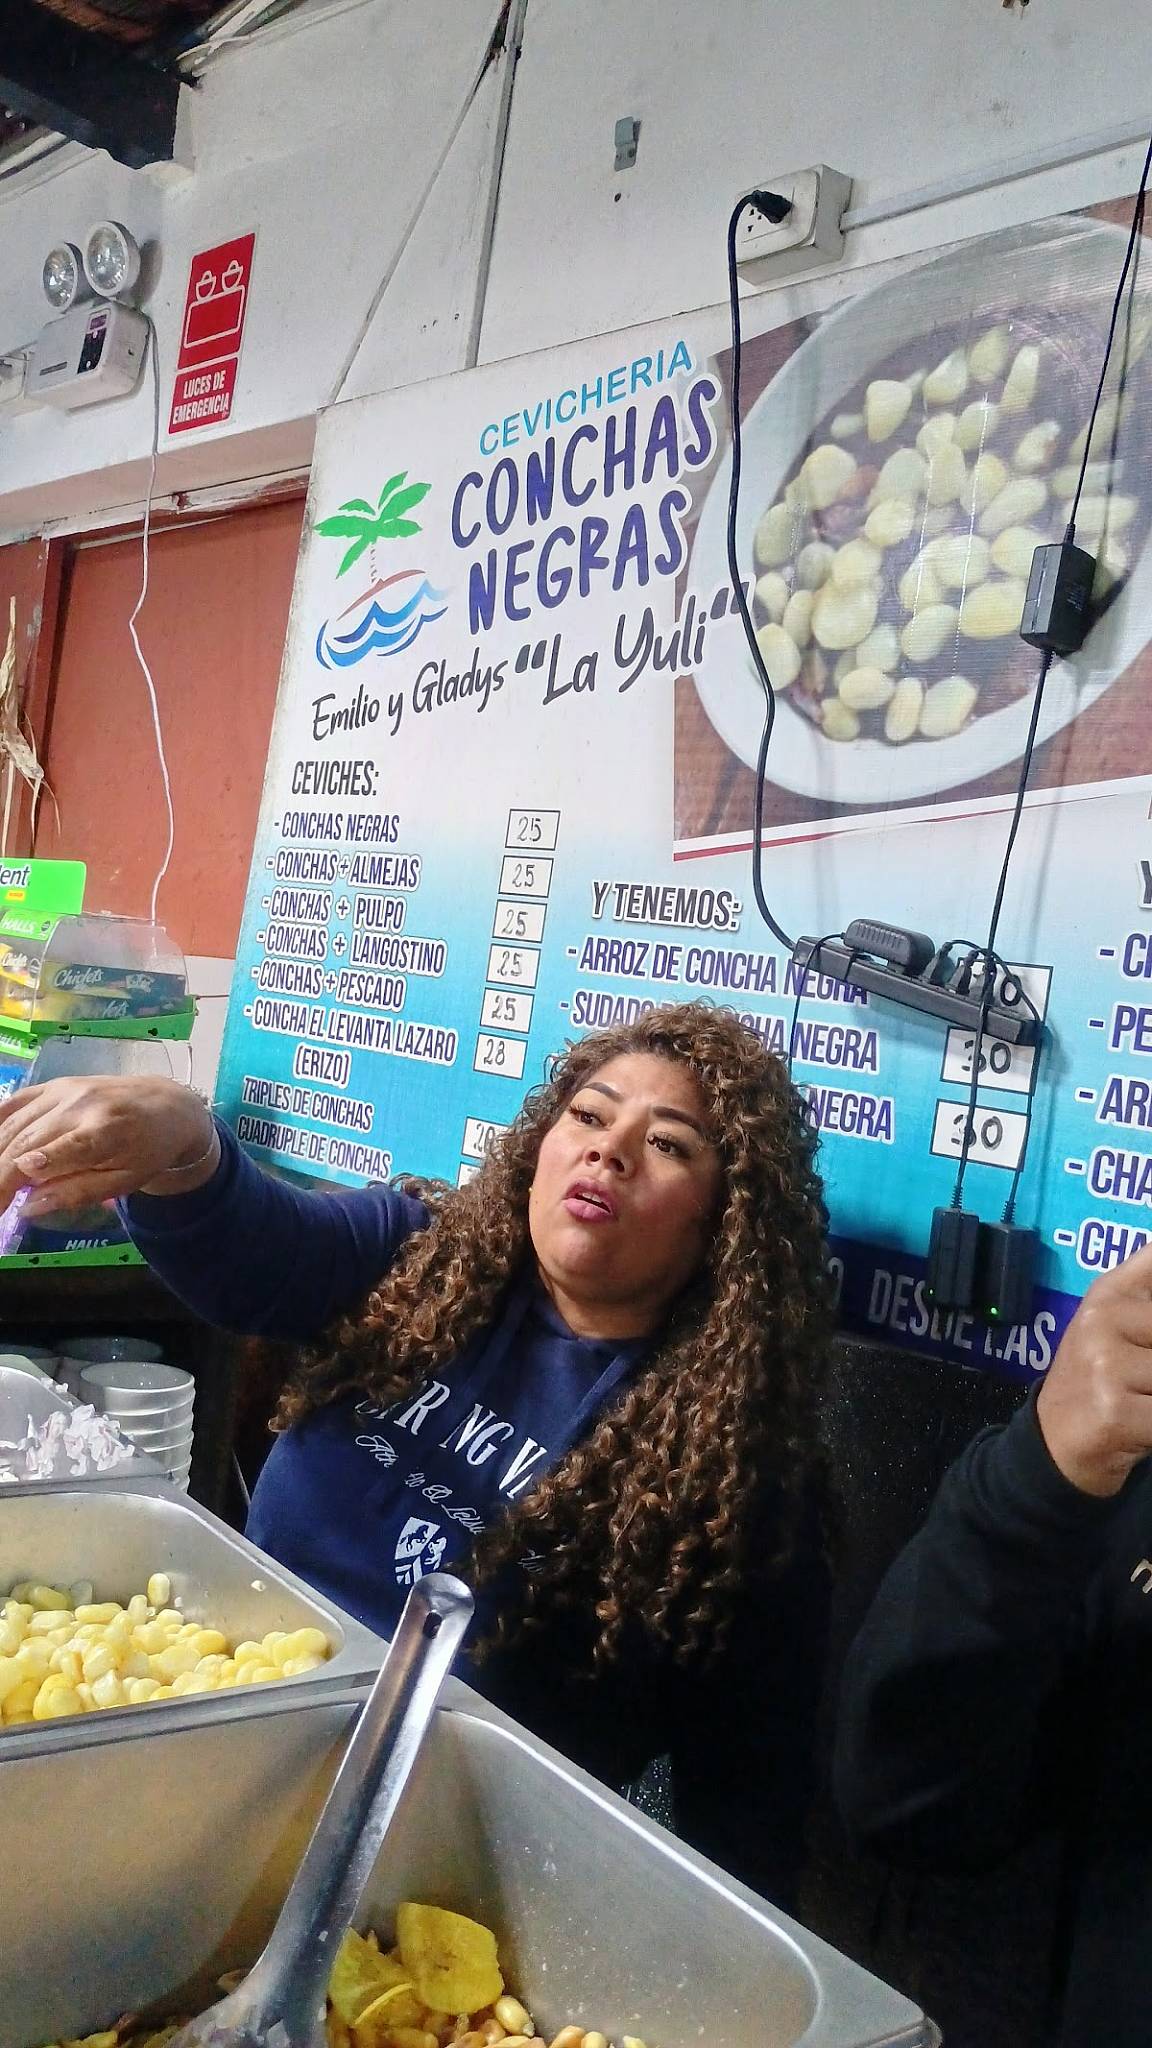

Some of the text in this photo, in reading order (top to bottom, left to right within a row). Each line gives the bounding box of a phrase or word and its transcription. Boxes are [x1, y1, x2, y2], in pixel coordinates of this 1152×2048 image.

[183, 370, 226, 399] LUCES DE
[479, 340, 693, 457] CEVICHERIA
[172, 392, 230, 425] EMERGENCIA
[451, 379, 717, 549] CONCHAS
[469, 491, 687, 635] NEGRAS
[312, 684, 380, 742] Emilio
[388, 690, 403, 736] y
[413, 648, 509, 714] Gladys
[291, 760, 380, 797] CEVICHES:
[345, 814, 401, 843] NEGRAS
[517, 816, 542, 842] 25
[350, 855, 419, 888] ALMEJAS
[512, 864, 536, 888] 25
[356, 897, 404, 930] PULPO
[501, 909, 529, 937] 25
[593, 881, 742, 929] Y TENEMOS:
[352, 933, 446, 974] LANGOSTINO
[496, 952, 524, 977] 25
[652, 944, 679, 980] DE
[685, 947, 777, 993] CONCHA
[339, 973, 405, 1009] PESCADO
[491, 994, 518, 1022] 25
[309, 1009, 325, 1038] EL
[327, 1011, 392, 1051] LEVANTA
[394, 1023, 457, 1063] LAZARO
[483, 1039, 506, 1066] 28
[792, 1023, 878, 1071] NEGRA
[295, 1045, 350, 1086] (ERIZO)
[242, 1077, 373, 1131] TRIPLES DE CONCHAS
[807, 1087, 892, 1140] NEGRA
[237, 1116, 391, 1179] CUADRUPLE DE CONCHAS
[65, 1239, 109, 1251] HALLS
